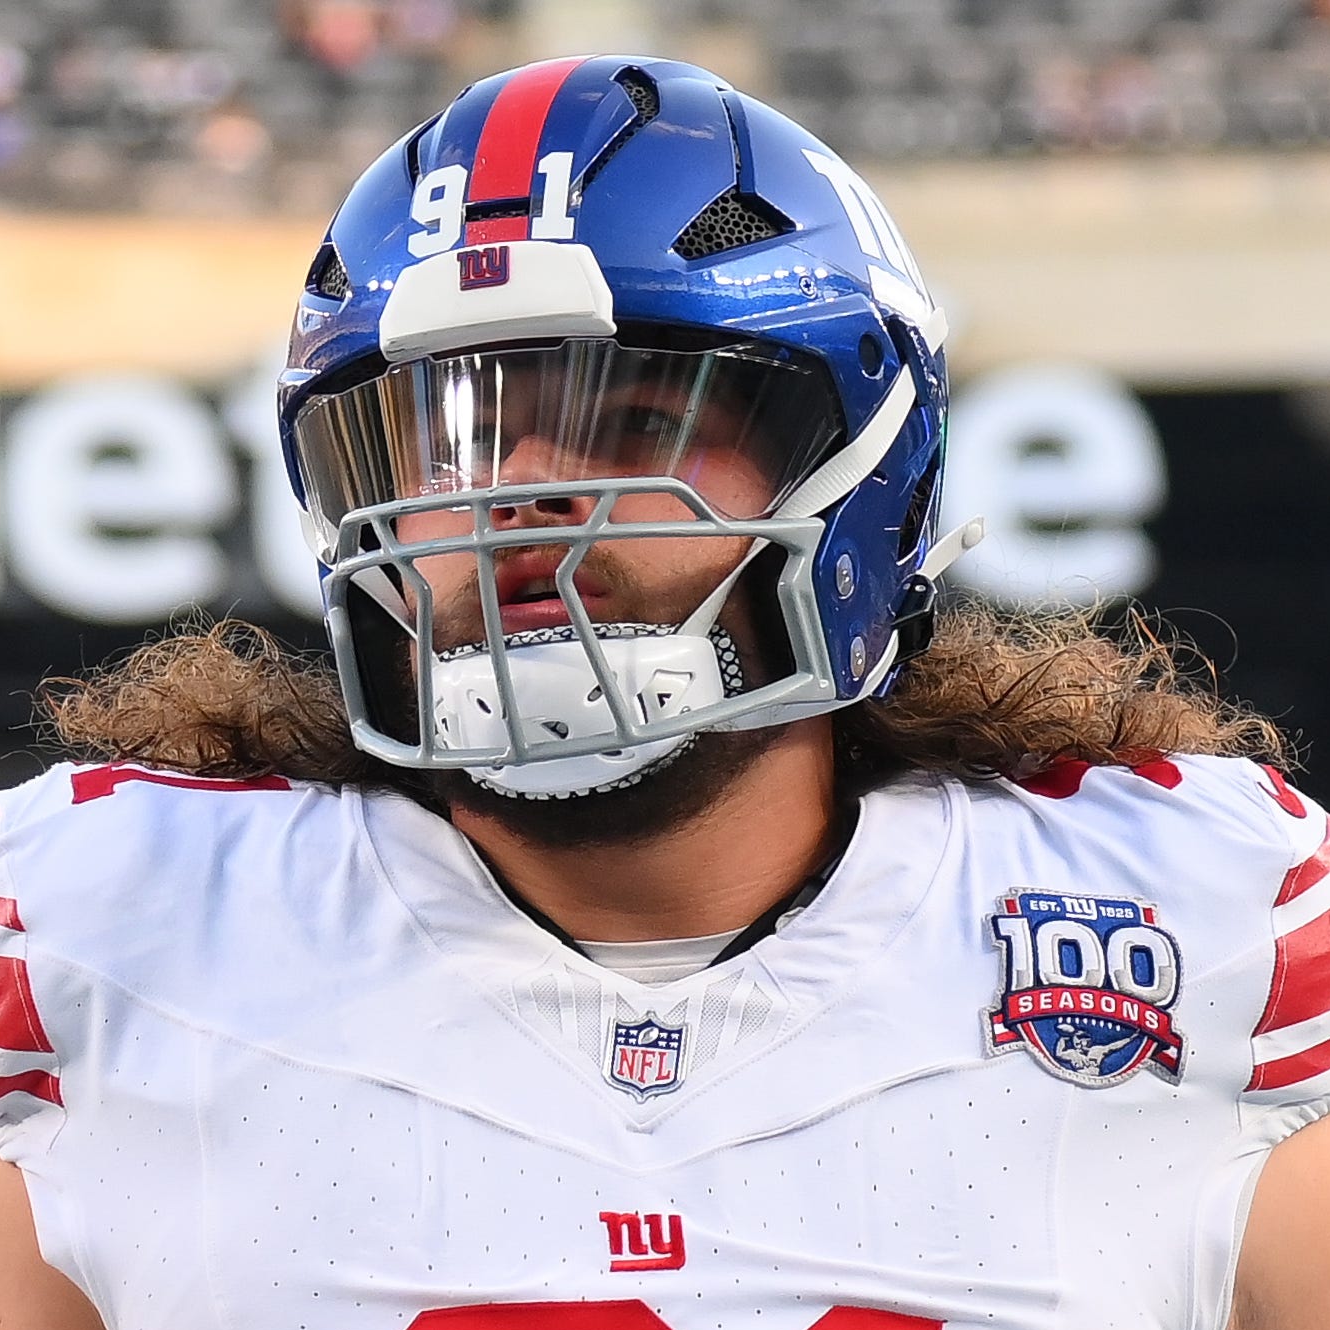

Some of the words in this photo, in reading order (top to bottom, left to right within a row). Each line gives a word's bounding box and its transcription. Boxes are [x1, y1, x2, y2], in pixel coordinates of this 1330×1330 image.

[996, 916, 1178, 1007] 100
[1017, 991, 1160, 1030] SEASONS
[616, 1047, 672, 1084] NFL
